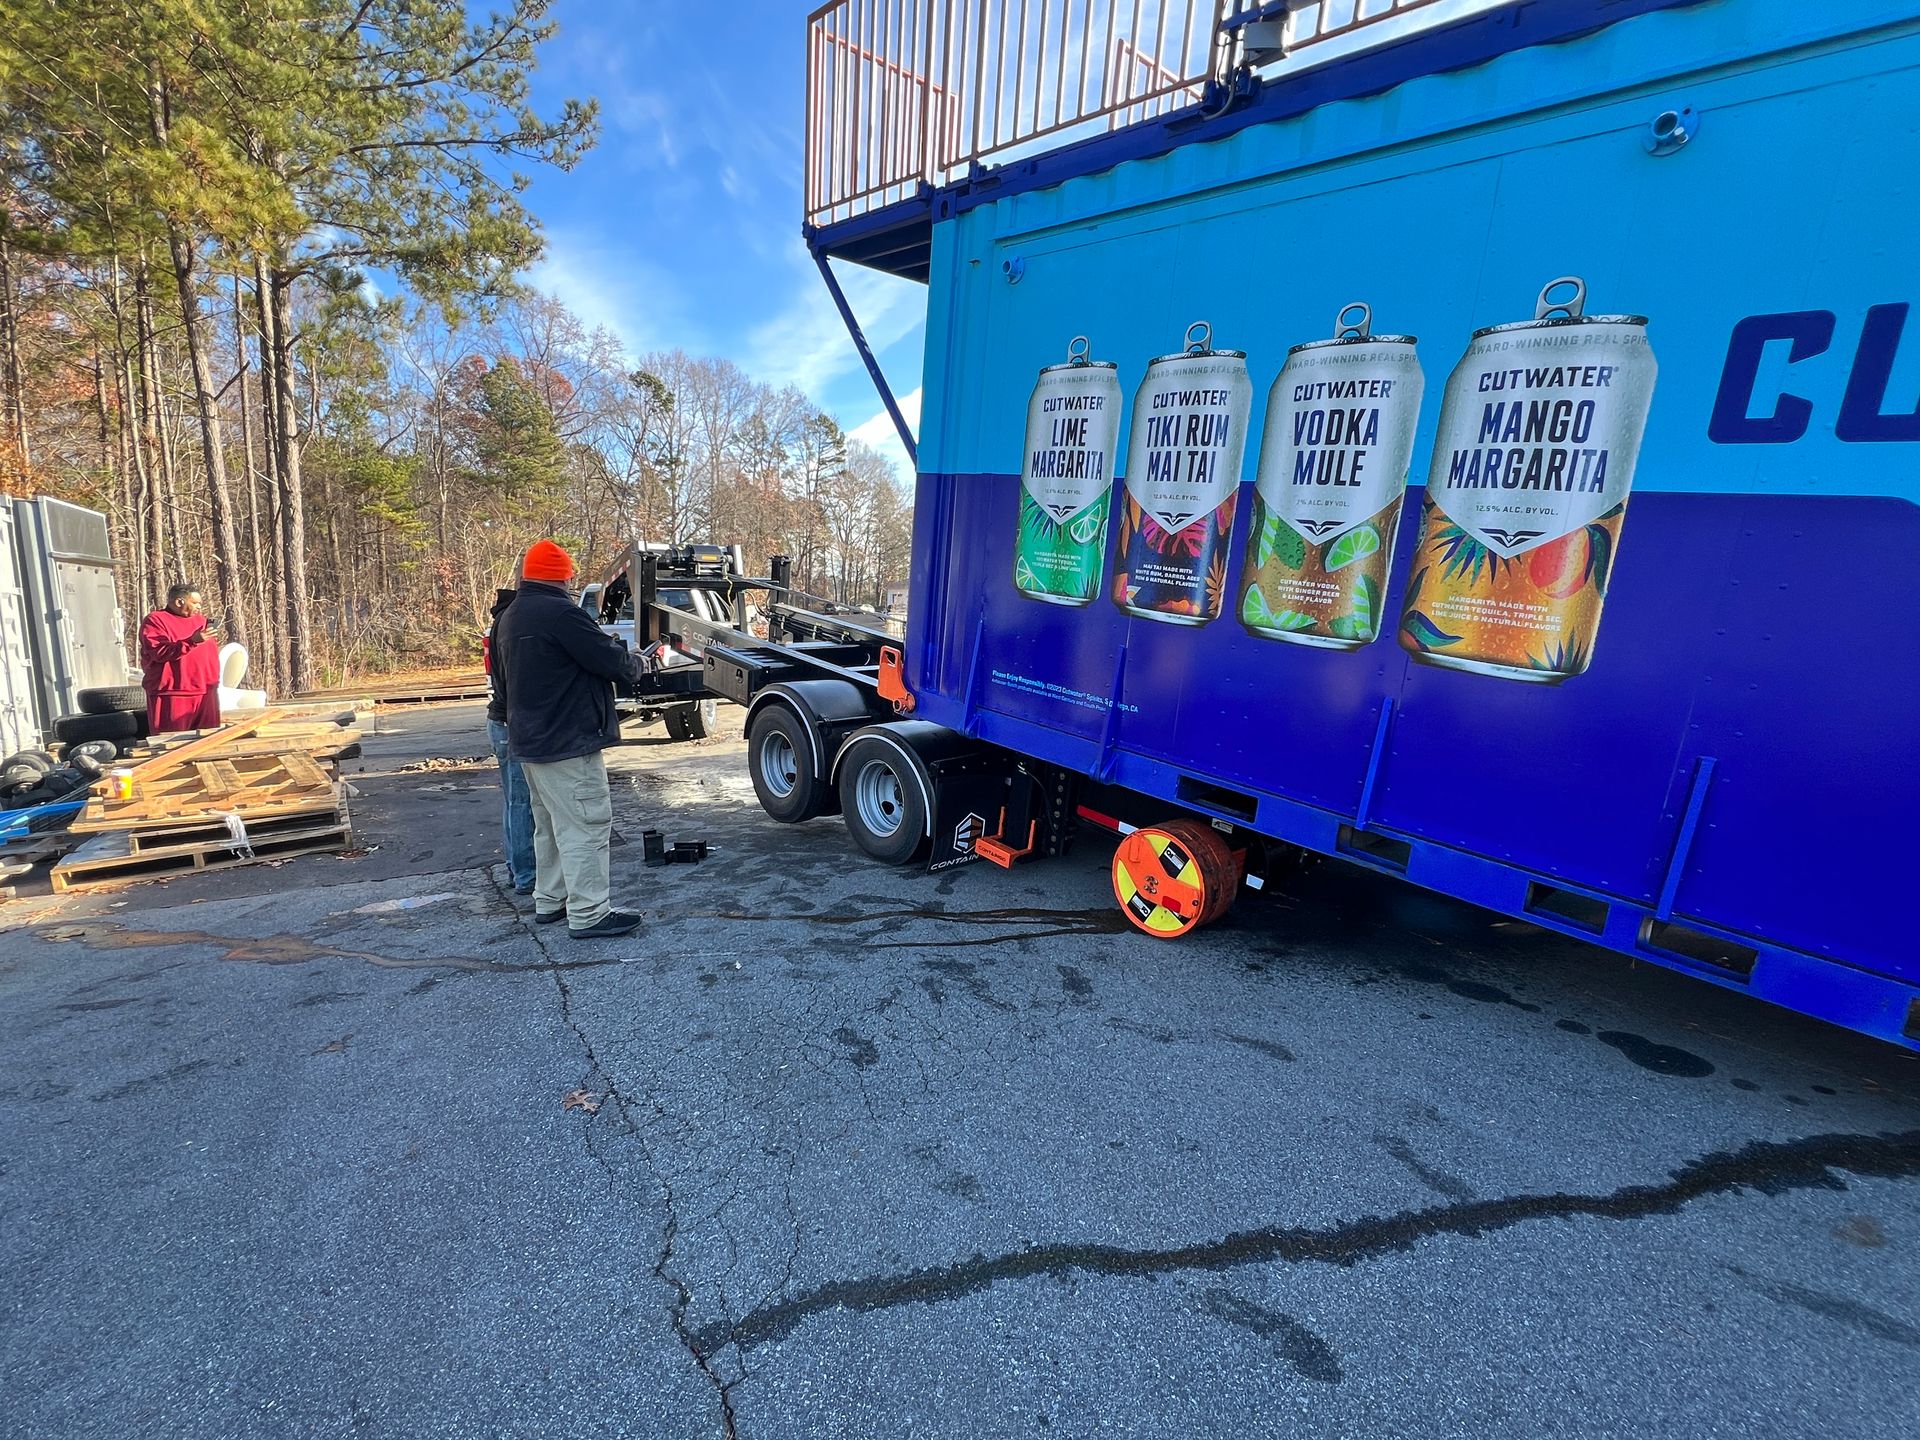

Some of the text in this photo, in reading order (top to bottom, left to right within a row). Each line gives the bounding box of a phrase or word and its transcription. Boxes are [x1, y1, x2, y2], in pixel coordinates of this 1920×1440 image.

[1470, 335, 1578, 356] AWARD-WINNING
[1584, 334, 1618, 346] REAL
[1287, 353, 1367, 370] AWARD-WINNING
[1370, 352, 1395, 362] REAL
[1478, 366, 1613, 393] CUTWATER
[1153, 389, 1228, 410] CUTWATER
[1293, 380, 1392, 402] CUTWATER
[1044, 396, 1103, 412] CUTWATER
[1146, 414, 1230, 448] TIKI RUM
[1293, 408, 1380, 446] VODKA
[1478, 400, 1595, 444] MANGO
[1052, 418, 1089, 447] LIME
[1031, 450, 1104, 480] MARGARITA
[1146, 450, 1217, 483] MAI TAI
[1292, 450, 1366, 487] MULE
[1447, 449, 1608, 493] MARGARITA
[1502, 506, 1524, 514] ALC.
[1539, 508, 1559, 516] VOL.
[1162, 565, 1178, 573] MADE
[1164, 572, 1186, 580] BARREL
[1150, 576, 1174, 585] NATURAL
[1175, 580, 1199, 588] FLAVORS
[1280, 579, 1340, 590] CUTWATER VODKA
[1295, 587, 1321, 595] GINGER
[1322, 590, 1340, 598] BEER
[1305, 596, 1333, 604] FLAVOR
[1449, 595, 1497, 606] MARGARITA
[1499, 602, 1525, 610] MADE
[1432, 602, 1470, 611] CUTWATER
[1471, 606, 1511, 618] TEQUILA,
[1513, 612, 1544, 621] TRIPLE
[1449, 612, 1472, 620] JUICE
[1481, 616, 1522, 627] NATURAL
[1524, 621, 1561, 632] FLAVORS
[992, 669, 1006, 679] Please
[1007, 672, 1018, 682] Enjoy
[1130, 705, 1138, 713] CA
[930, 853, 980, 870] CONTAIN
